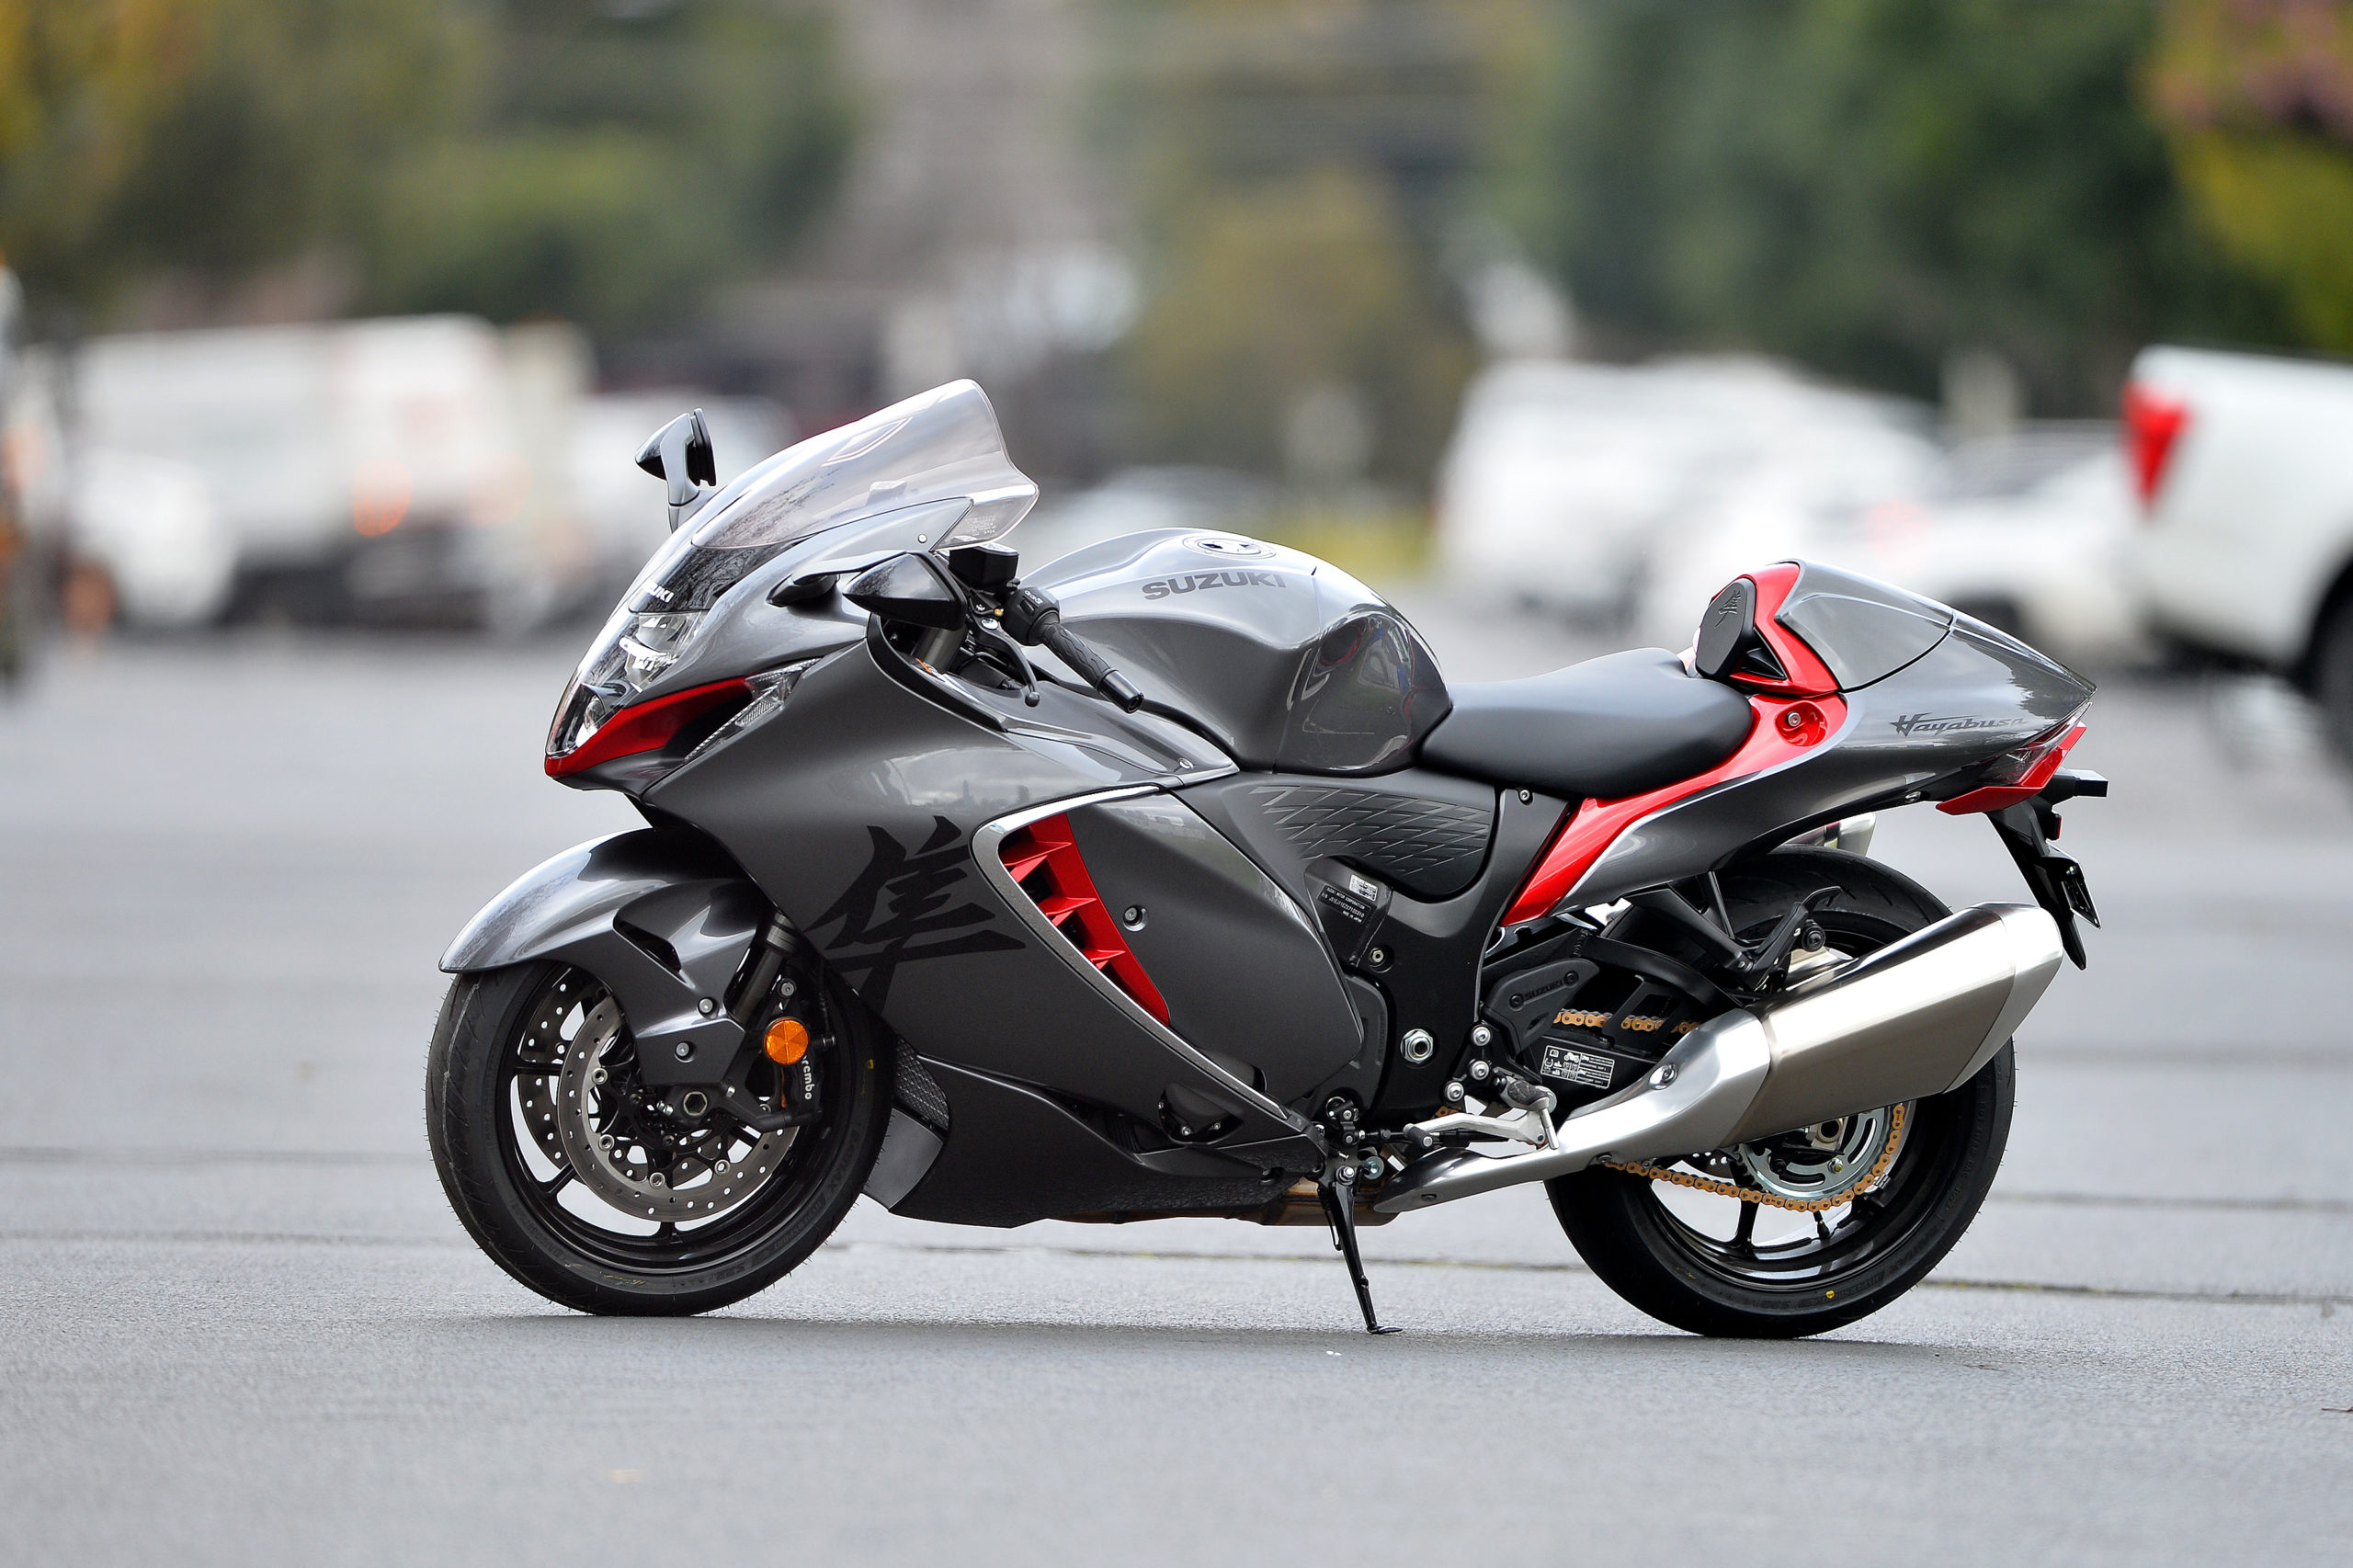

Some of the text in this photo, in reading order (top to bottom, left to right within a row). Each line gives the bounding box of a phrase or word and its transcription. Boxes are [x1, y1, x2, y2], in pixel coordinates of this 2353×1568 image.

[1142, 572, 1286, 600] SUZUKI
[1890, 712, 2028, 736] Hayabusa
[801, 815, 1027, 1017] 隼
[1525, 979, 1562, 1000] SUZUKI
[802, 1056, 815, 1100] rembo
